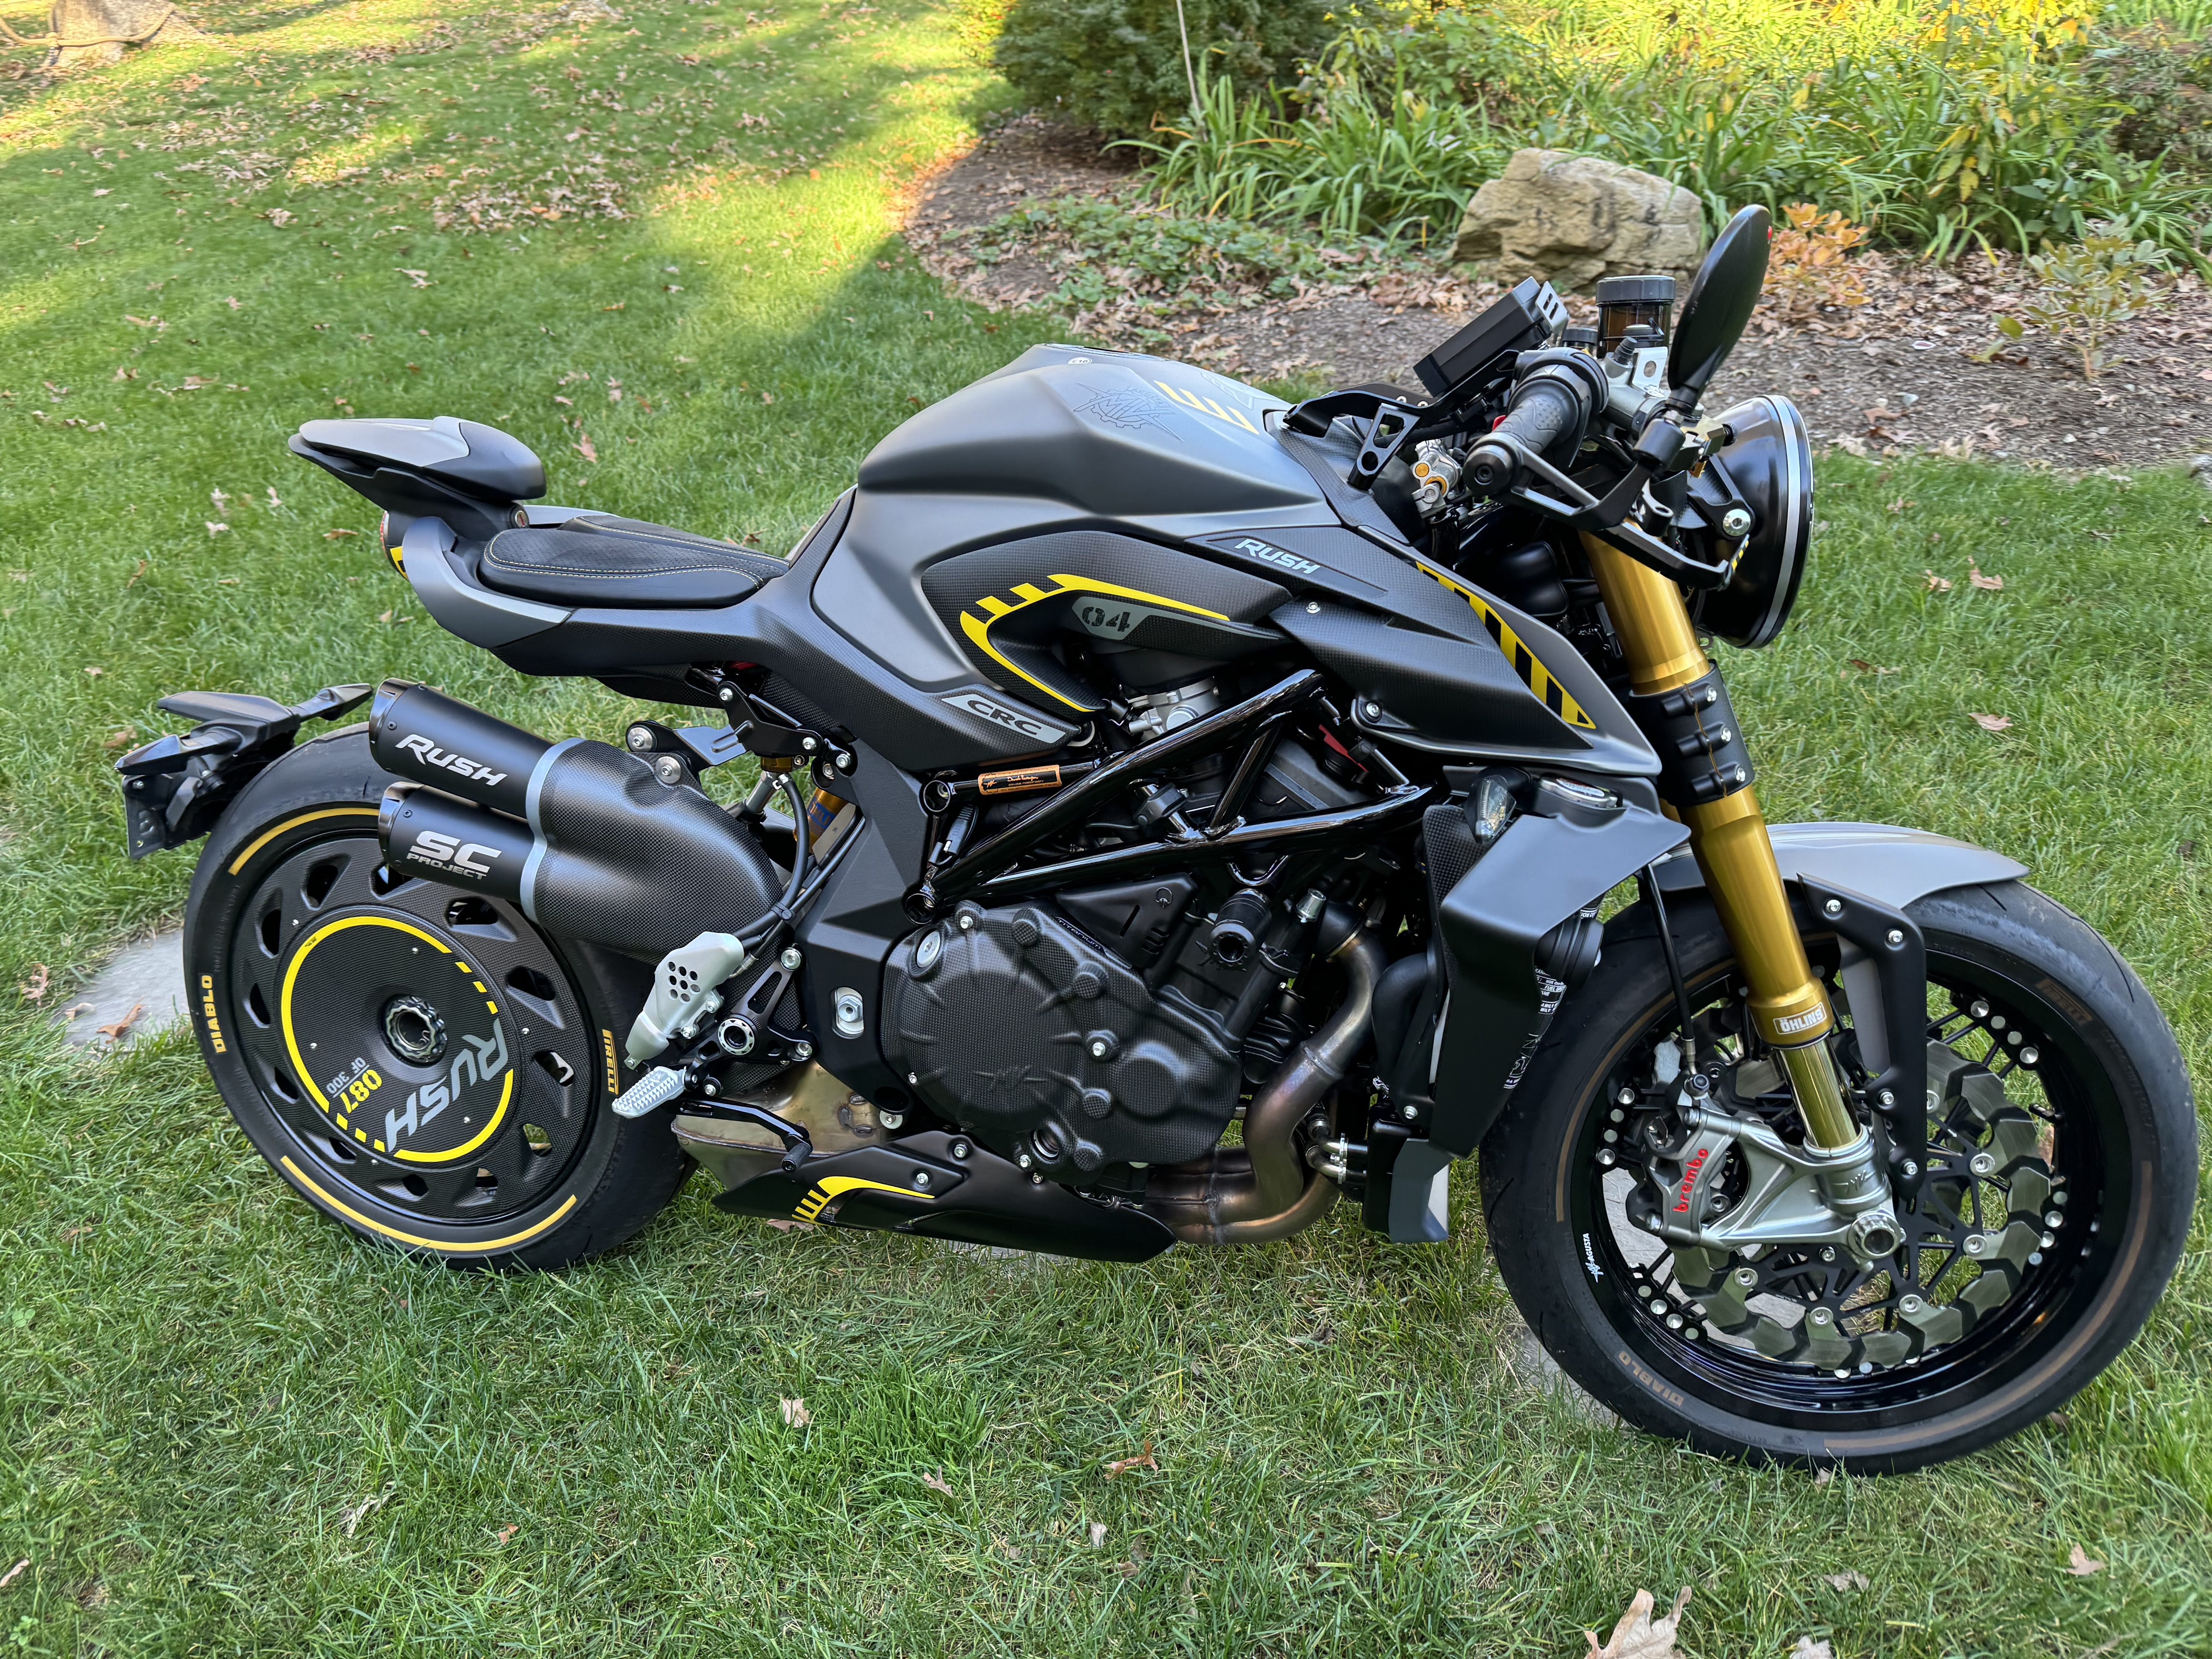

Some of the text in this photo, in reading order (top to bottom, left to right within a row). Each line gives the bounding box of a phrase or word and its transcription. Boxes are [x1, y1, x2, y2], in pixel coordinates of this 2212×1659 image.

[1235, 539, 1321, 574] RUSH
[1082, 606, 1130, 632] 04
[967, 700, 1042, 735] CRC
[395, 734, 508, 786] RUSH
[406, 852, 487, 880] PROJECT
[410, 830, 502, 873] SC
[201, 975, 227, 1053] DIABLO
[1779, 1007, 1823, 1032] ÖHLINS
[326, 1057, 366, 1094] OF 300
[602, 1029, 619, 1095] PIRELLI
[340, 1069, 382, 1113] 087
[385, 1017, 508, 1153] RUSH
[1672, 1148, 1709, 1212] brembo
[1583, 1233, 1595, 1261] AGUSTA
[1618, 1350, 1684, 1407] DIABLO
